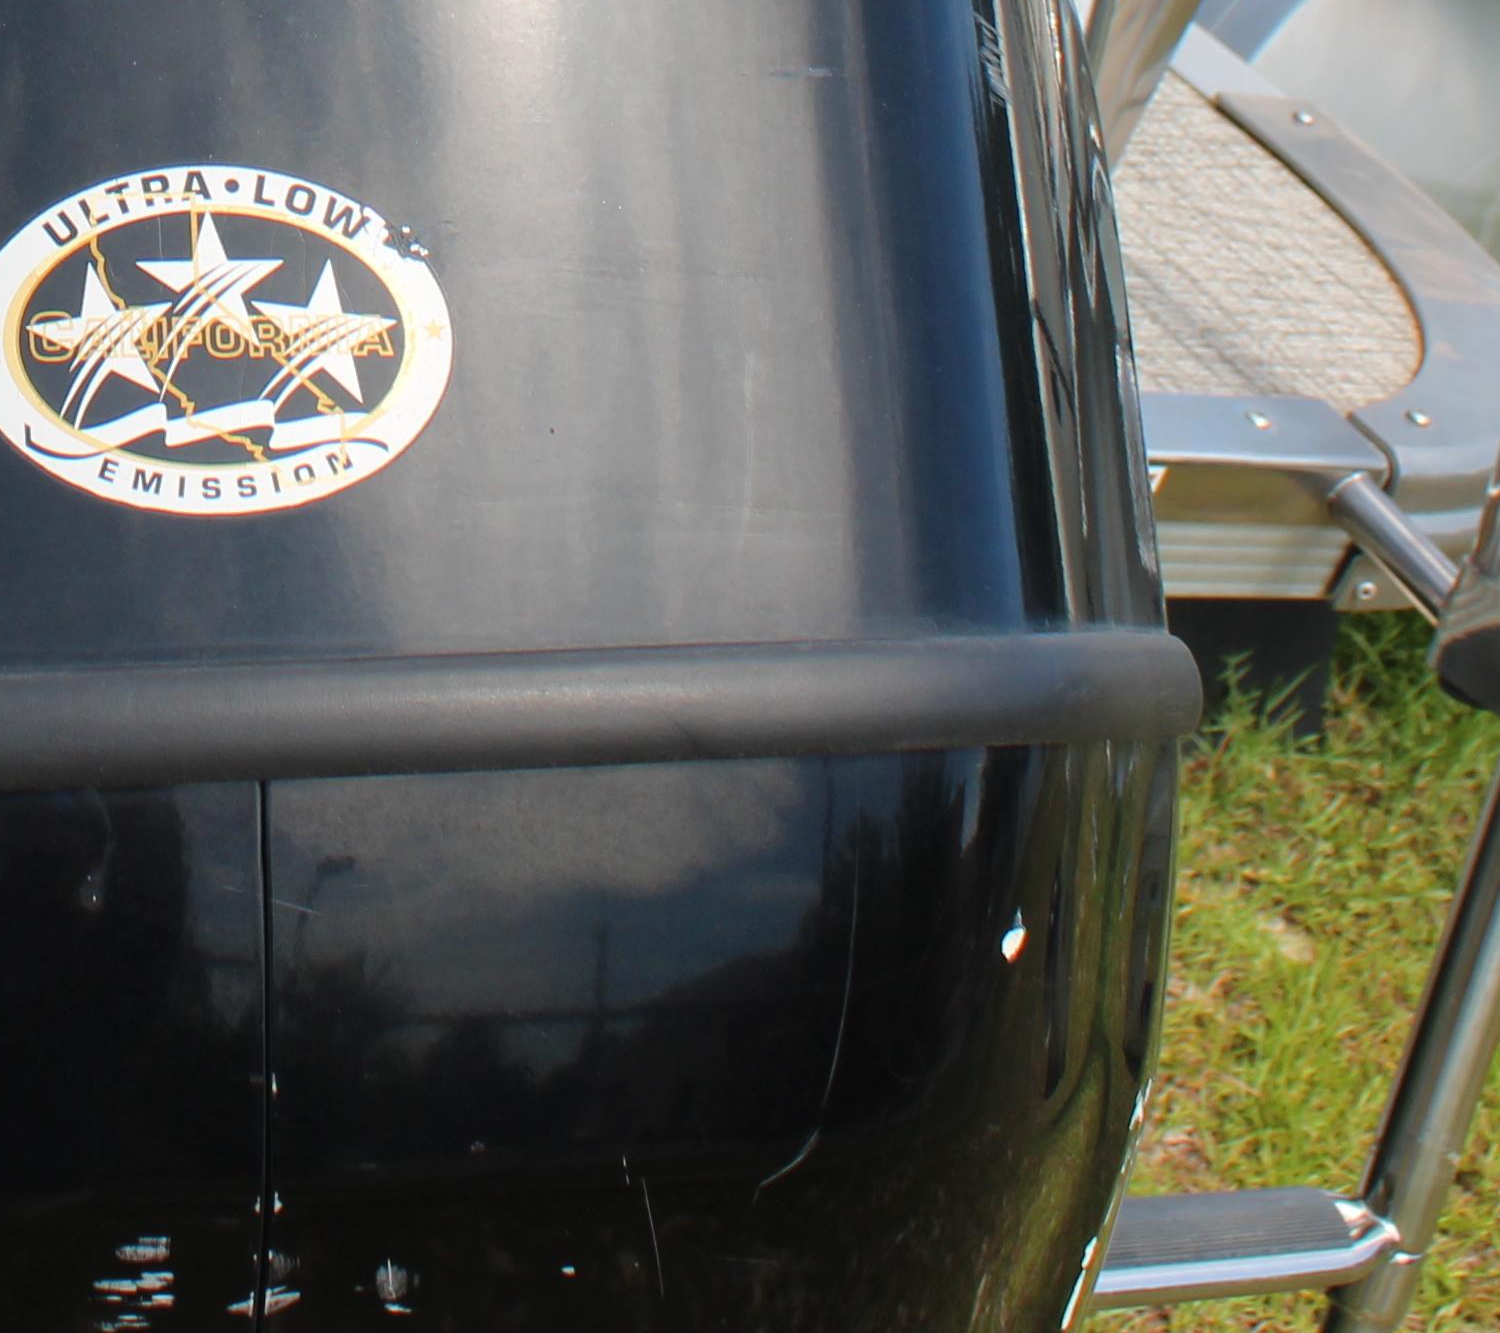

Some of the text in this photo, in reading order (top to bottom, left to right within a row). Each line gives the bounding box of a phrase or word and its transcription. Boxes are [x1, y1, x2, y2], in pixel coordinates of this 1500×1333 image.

[41, 170, 372, 248] ULTRA LOW
[28, 309, 395, 362] CALIFORNIA
[97, 454, 354, 500] EMISSION
